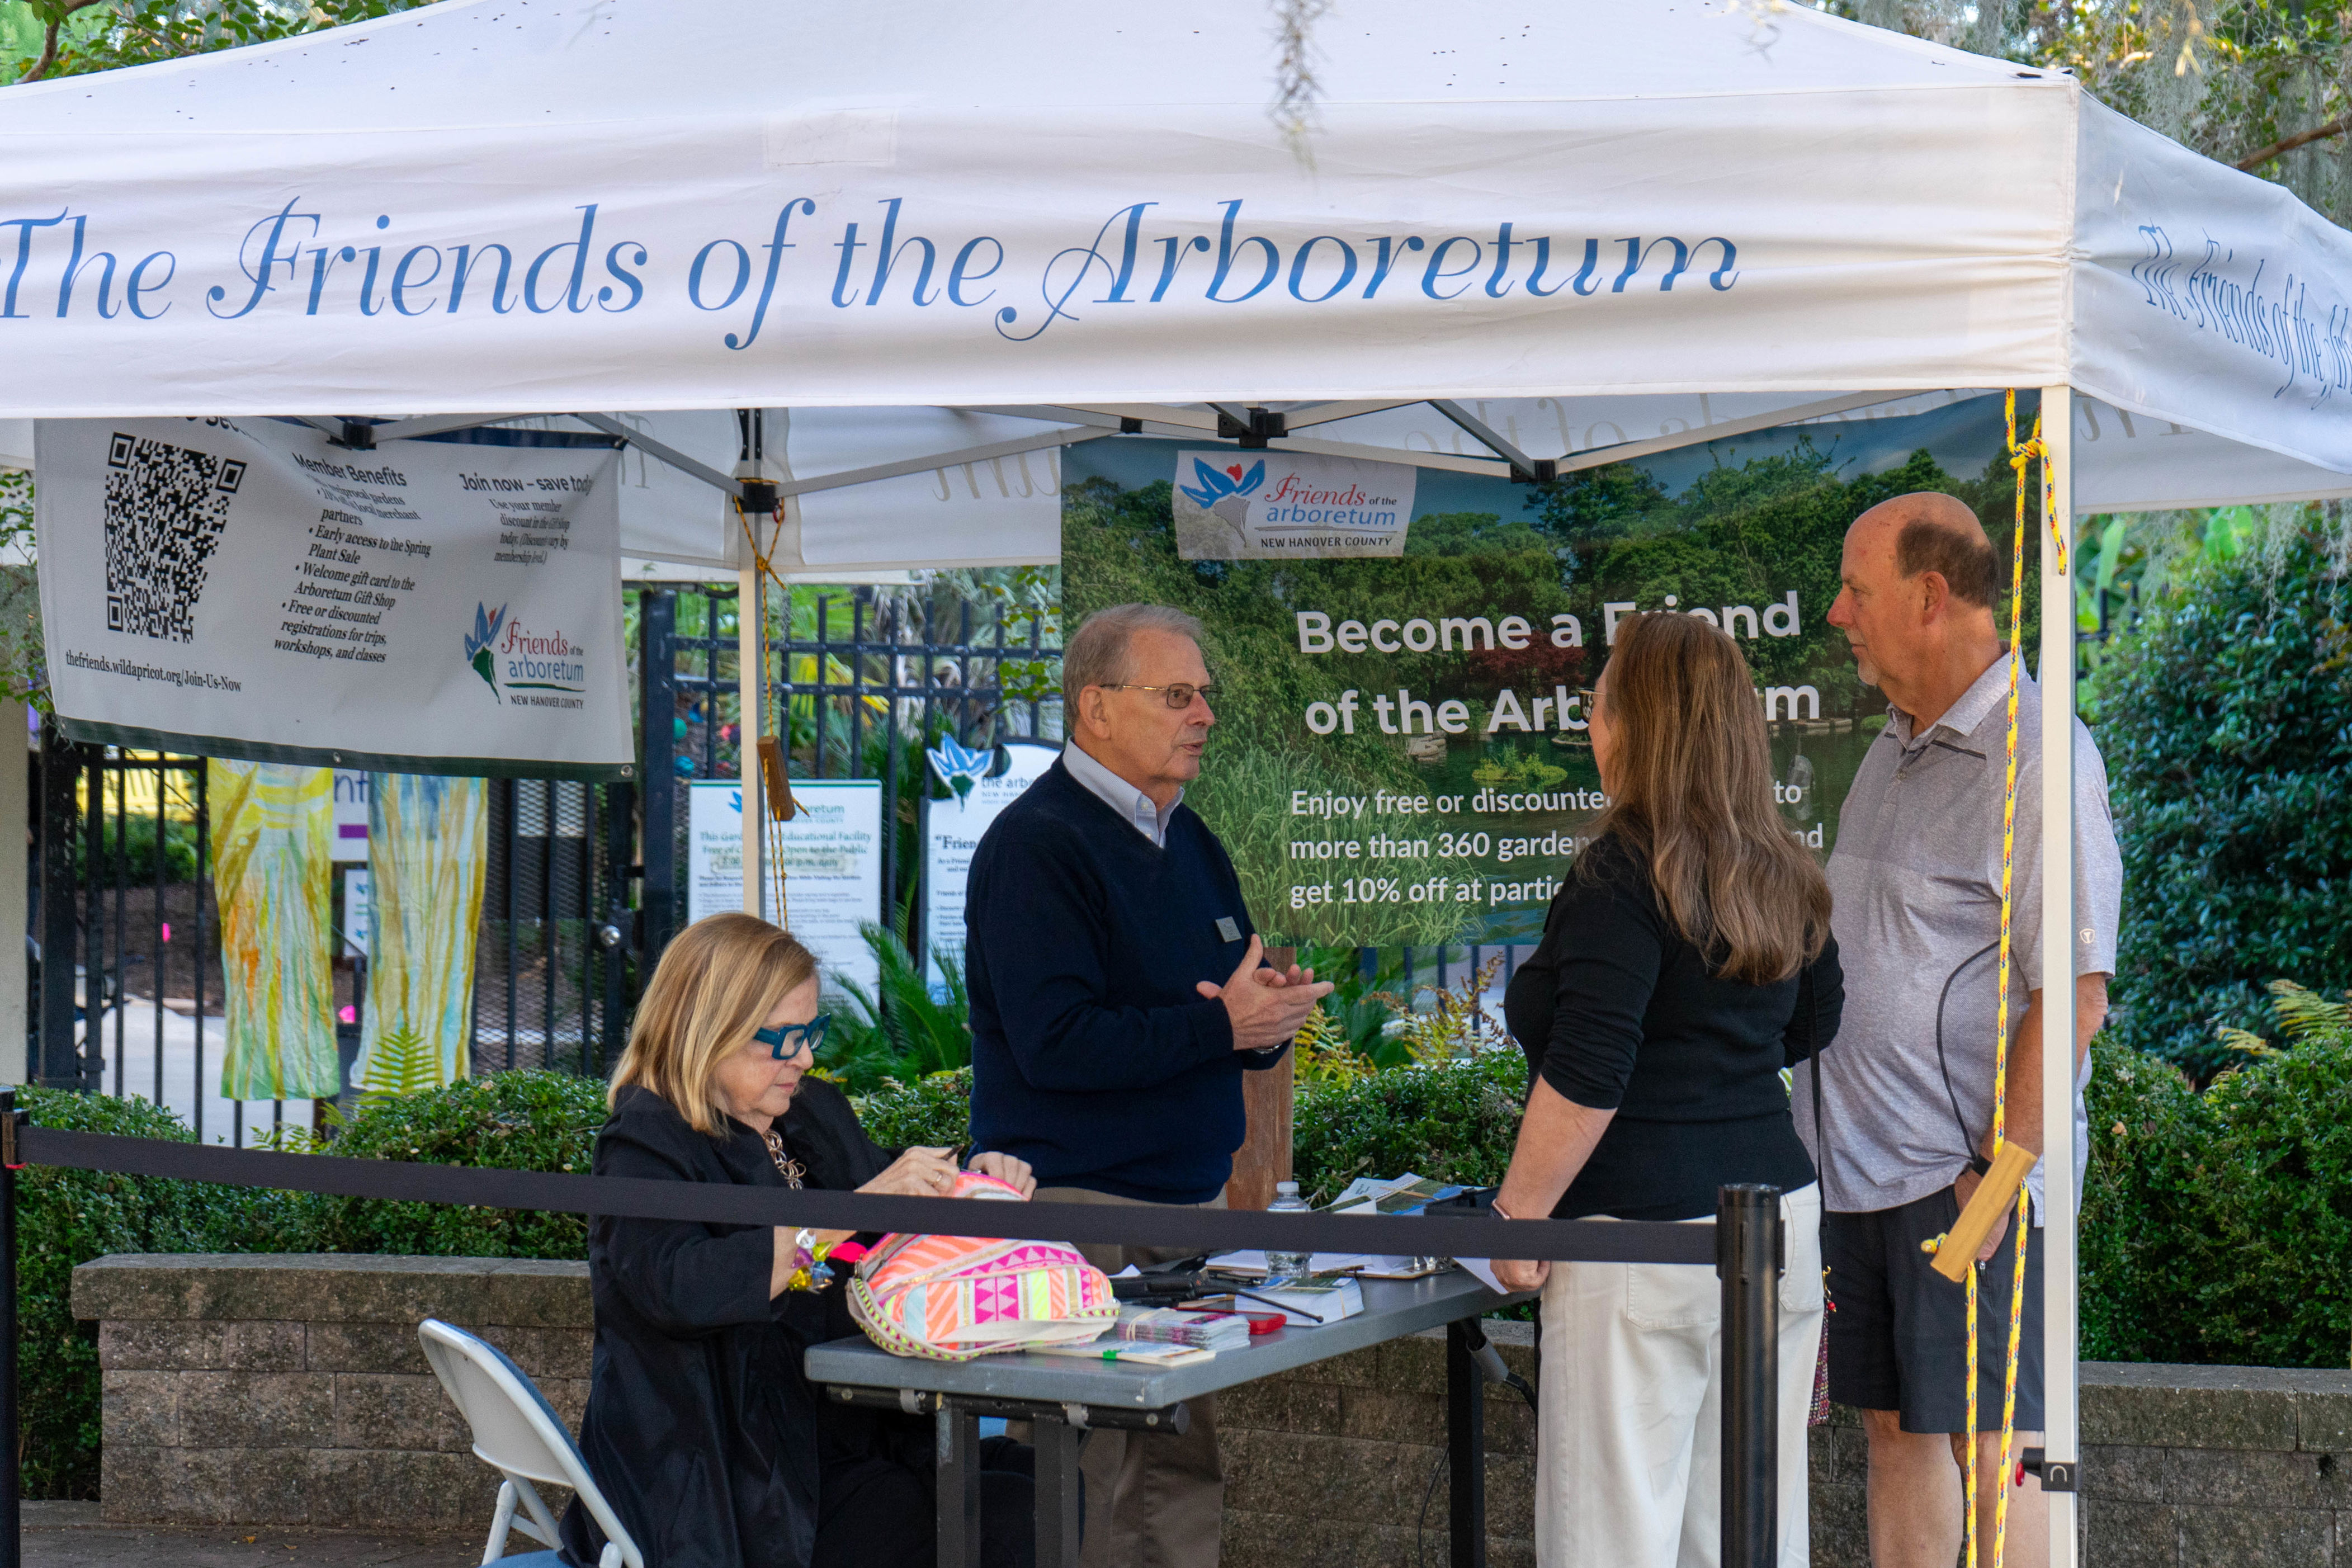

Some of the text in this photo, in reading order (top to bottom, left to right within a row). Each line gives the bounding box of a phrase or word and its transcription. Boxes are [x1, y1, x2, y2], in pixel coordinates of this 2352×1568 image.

[0, 195, 1739, 350] The Friends of the Arboretum
[2185, 227, 2274, 358] Friends
[2273, 273, 2294, 399] of
[2294, 283, 2325, 382] the
[292, 452, 347, 479] Member
[346, 464, 407, 487] Benefits
[459, 473, 492, 491] Join
[492, 478, 524, 491] now
[536, 478, 569, 491] save
[1264, 472, 1397, 506] Friends of the
[320, 508, 363, 526] partners
[489, 499, 562, 512] Use your member
[1267, 504, 1396, 526] arboretum
[500, 513, 532, 528] discount
[308, 543, 361, 564] Plant Sale
[315, 525, 432, 558] Early access to the Spring
[1261, 537, 1392, 547] NEW HANOVER COUNTY
[303, 561, 415, 591] Welcome gift card to the
[294, 581, 396, 610] Arboretum Gift Shop
[287, 599, 382, 625] Free or discounted
[1297, 590, 1801, 653] Become a Fnd
[281, 620, 387, 646] registrations for trips,
[501, 617, 568, 656] Friends
[274, 639, 387, 663] workshops, and classes
[66, 649, 242, 692] thefriends.wildapricot.org/Join-Us-Now
[508, 654, 584, 681] arboretum
[511, 695, 584, 709] NEW HANOVER COUNTY
[1305, 689, 1358, 734] of
[1373, 689, 1470, 734] the
[1291, 780, 1802, 820] Enjoy free or discounte to
[1291, 839, 1361, 859] more
[1368, 833, 1429, 858] than
[1437, 832, 1491, 857] 360
[1290, 880, 1334, 909] get
[1342, 878, 1400, 903] 10%
[1409, 876, 1448, 903] off
[1455, 879, 1482, 901] at
